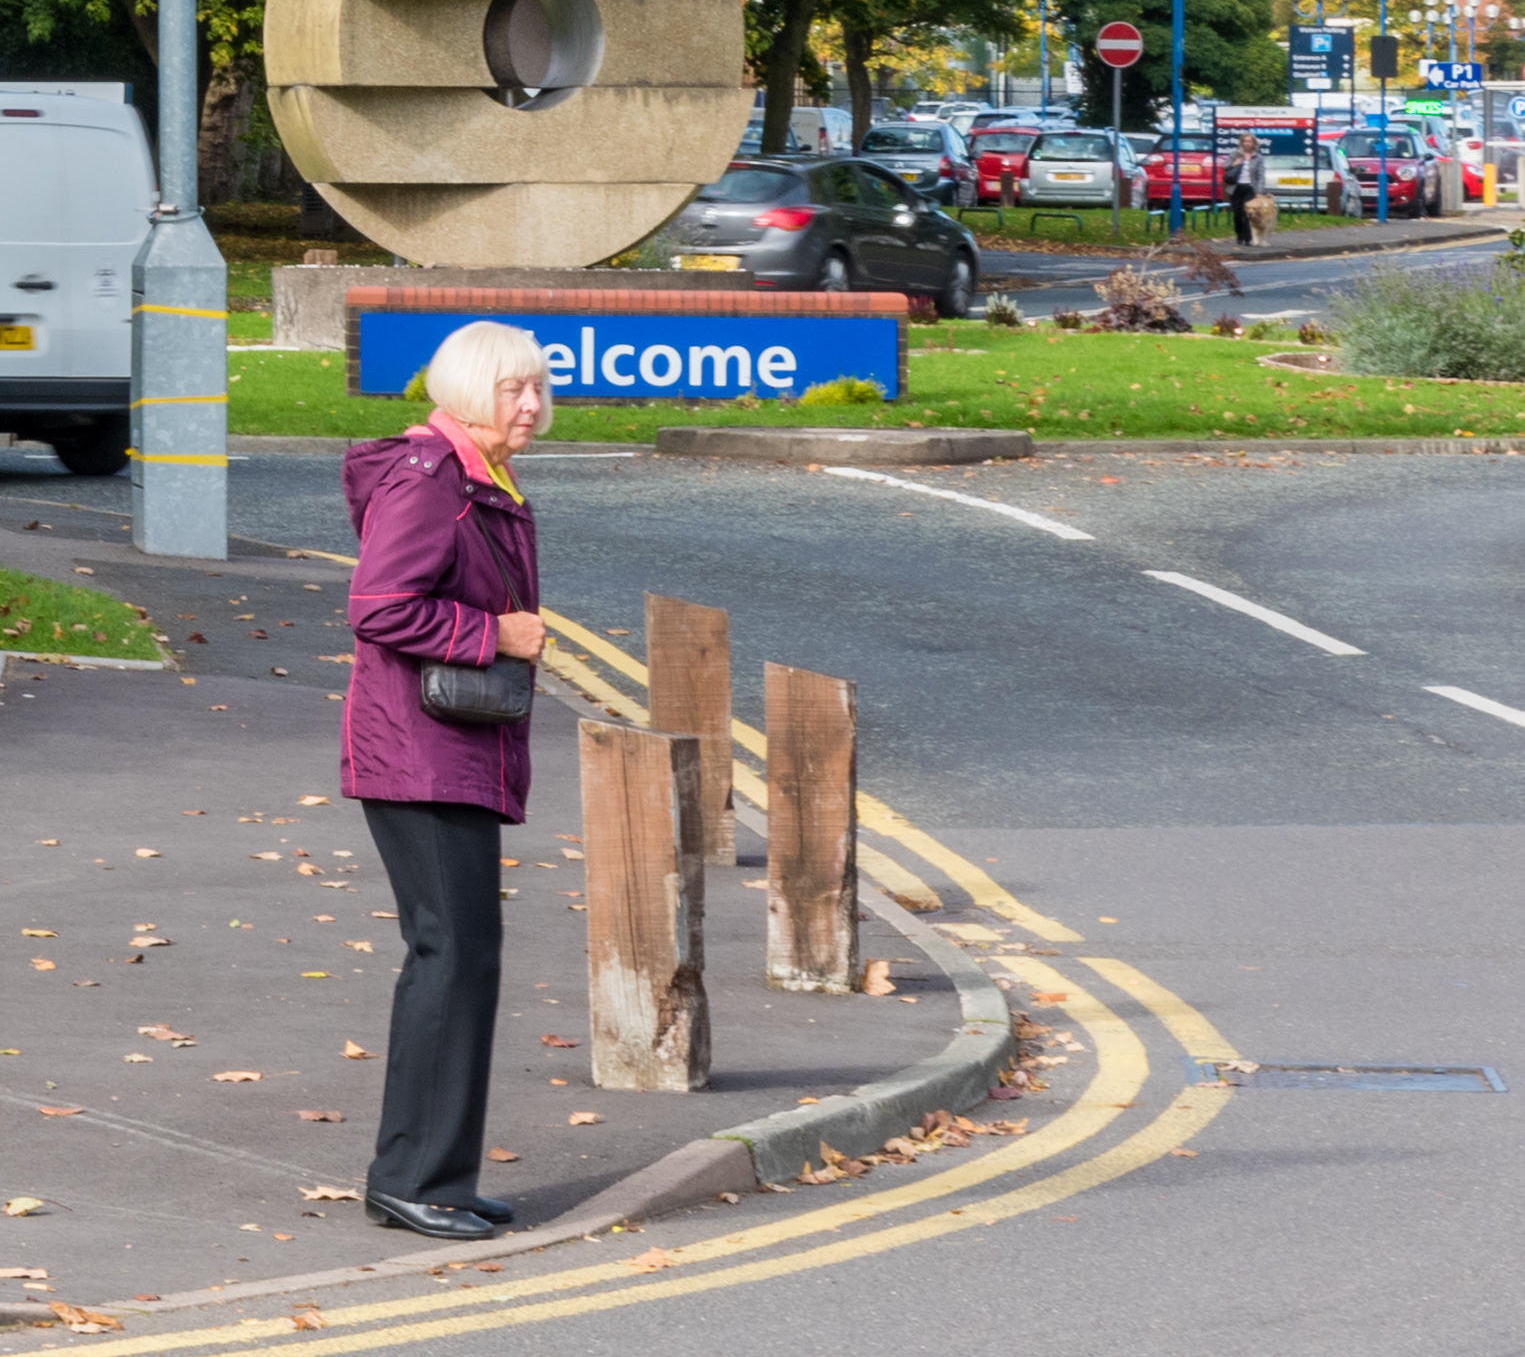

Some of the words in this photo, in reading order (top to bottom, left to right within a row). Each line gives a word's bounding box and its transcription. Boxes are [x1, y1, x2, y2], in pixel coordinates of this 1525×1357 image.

[1452, 64, 1473, 80] P1
[1444, 80, 1459, 88] Car
[1460, 80, 1480, 88] Park
[524, 326, 798, 388] elcome
